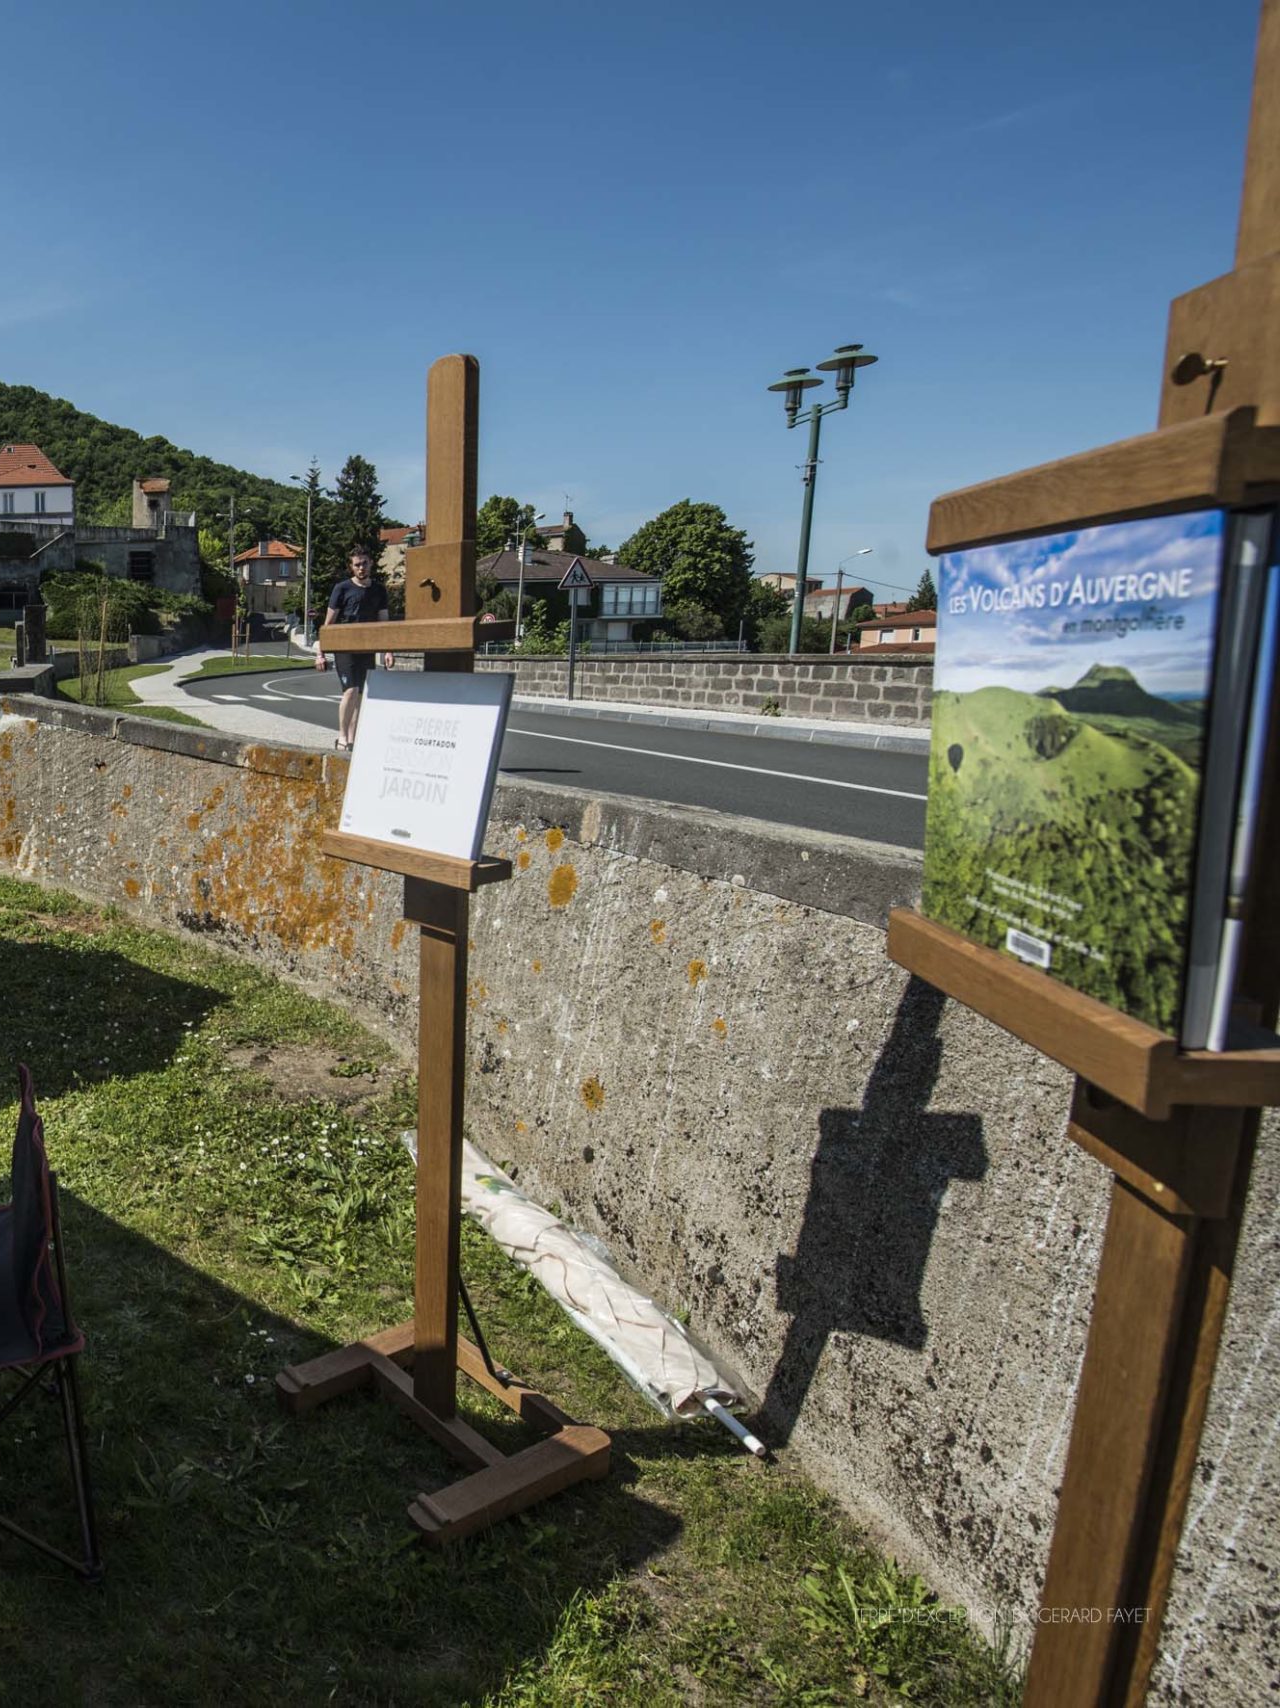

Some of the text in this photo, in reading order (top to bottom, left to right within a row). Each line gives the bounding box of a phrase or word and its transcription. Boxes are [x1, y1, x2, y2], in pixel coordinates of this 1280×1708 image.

[949, 568, 1194, 615] LES VOLCANS D'AUVERGNE
[415, 716, 461, 739] PIERRE
[414, 737, 457, 750] COURTADON
[378, 775, 448, 805] JARDIN
